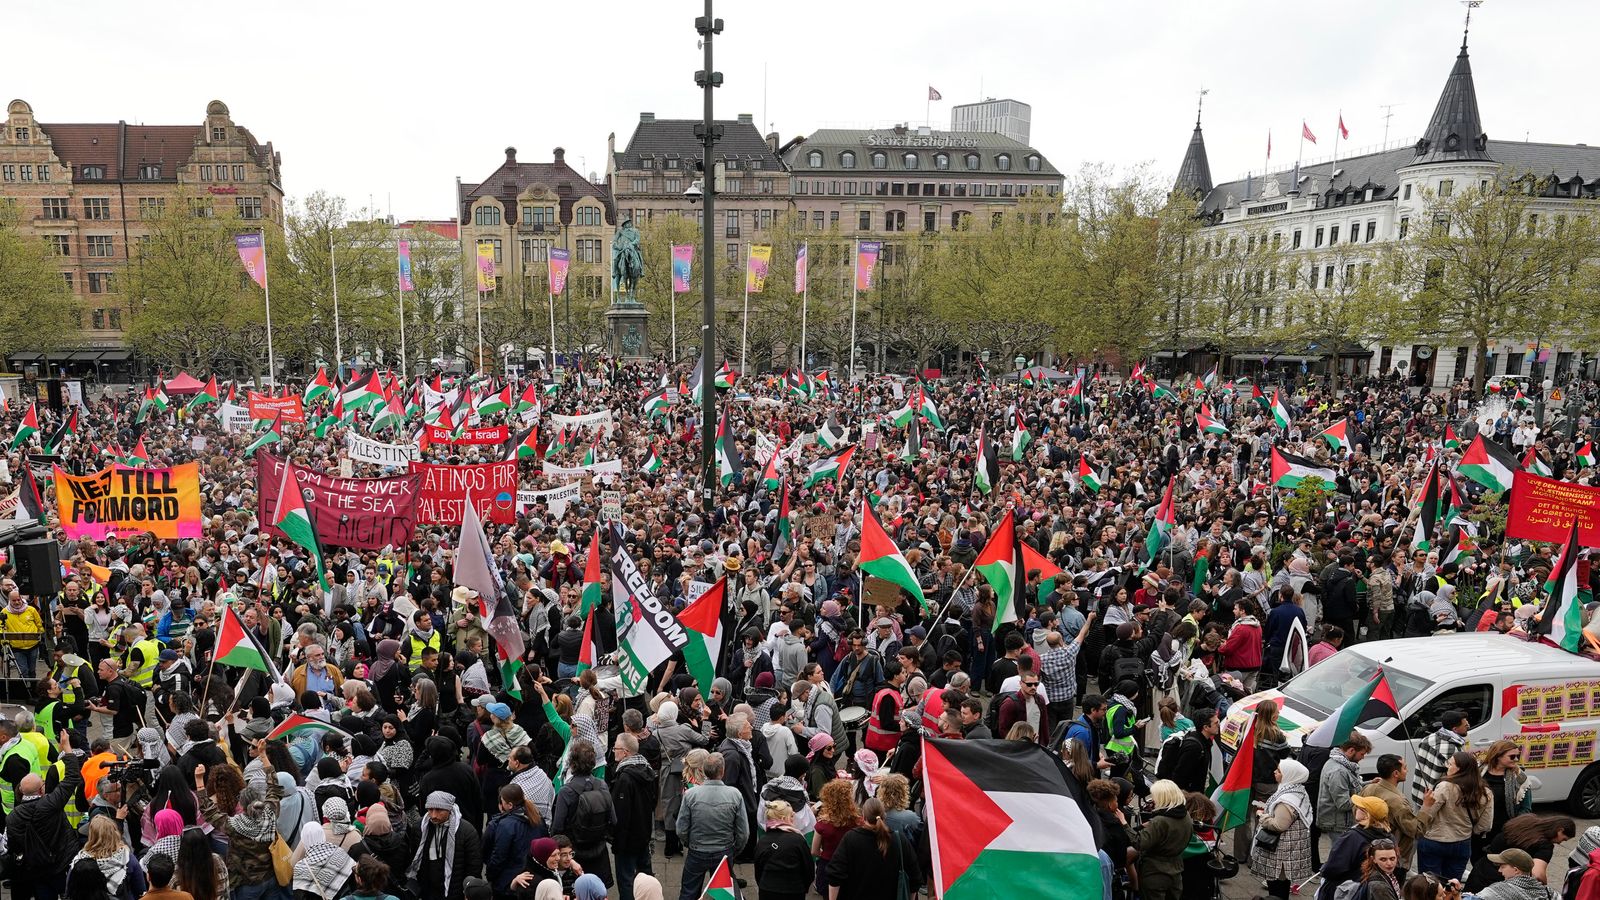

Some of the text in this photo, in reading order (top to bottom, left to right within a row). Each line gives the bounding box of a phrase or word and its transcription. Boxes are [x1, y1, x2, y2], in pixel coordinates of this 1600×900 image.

[867, 134, 980, 149] Stena Fastigheter
[759, 260, 768, 282] MUSIC
[476, 429, 500, 440] Israel
[66, 470, 112, 500] NEJ
[116, 469, 177, 494] TILL
[274, 462, 321, 485] FOM
[365, 480, 411, 495] RIVER
[493, 464, 516, 490] FOR
[1542, 482, 1557, 490] DEN
[323, 491, 357, 509] THE
[362, 496, 396, 514] SEA
[549, 487, 579, 501] PALESTINE
[72, 496, 179, 524] FOLKMORD
[1542, 509, 1563, 517] GØRE
[1564, 512, 1591, 521] OPØR!
[337, 513, 411, 546] RIGHTS
[611, 545, 690, 648] FREEDOM
